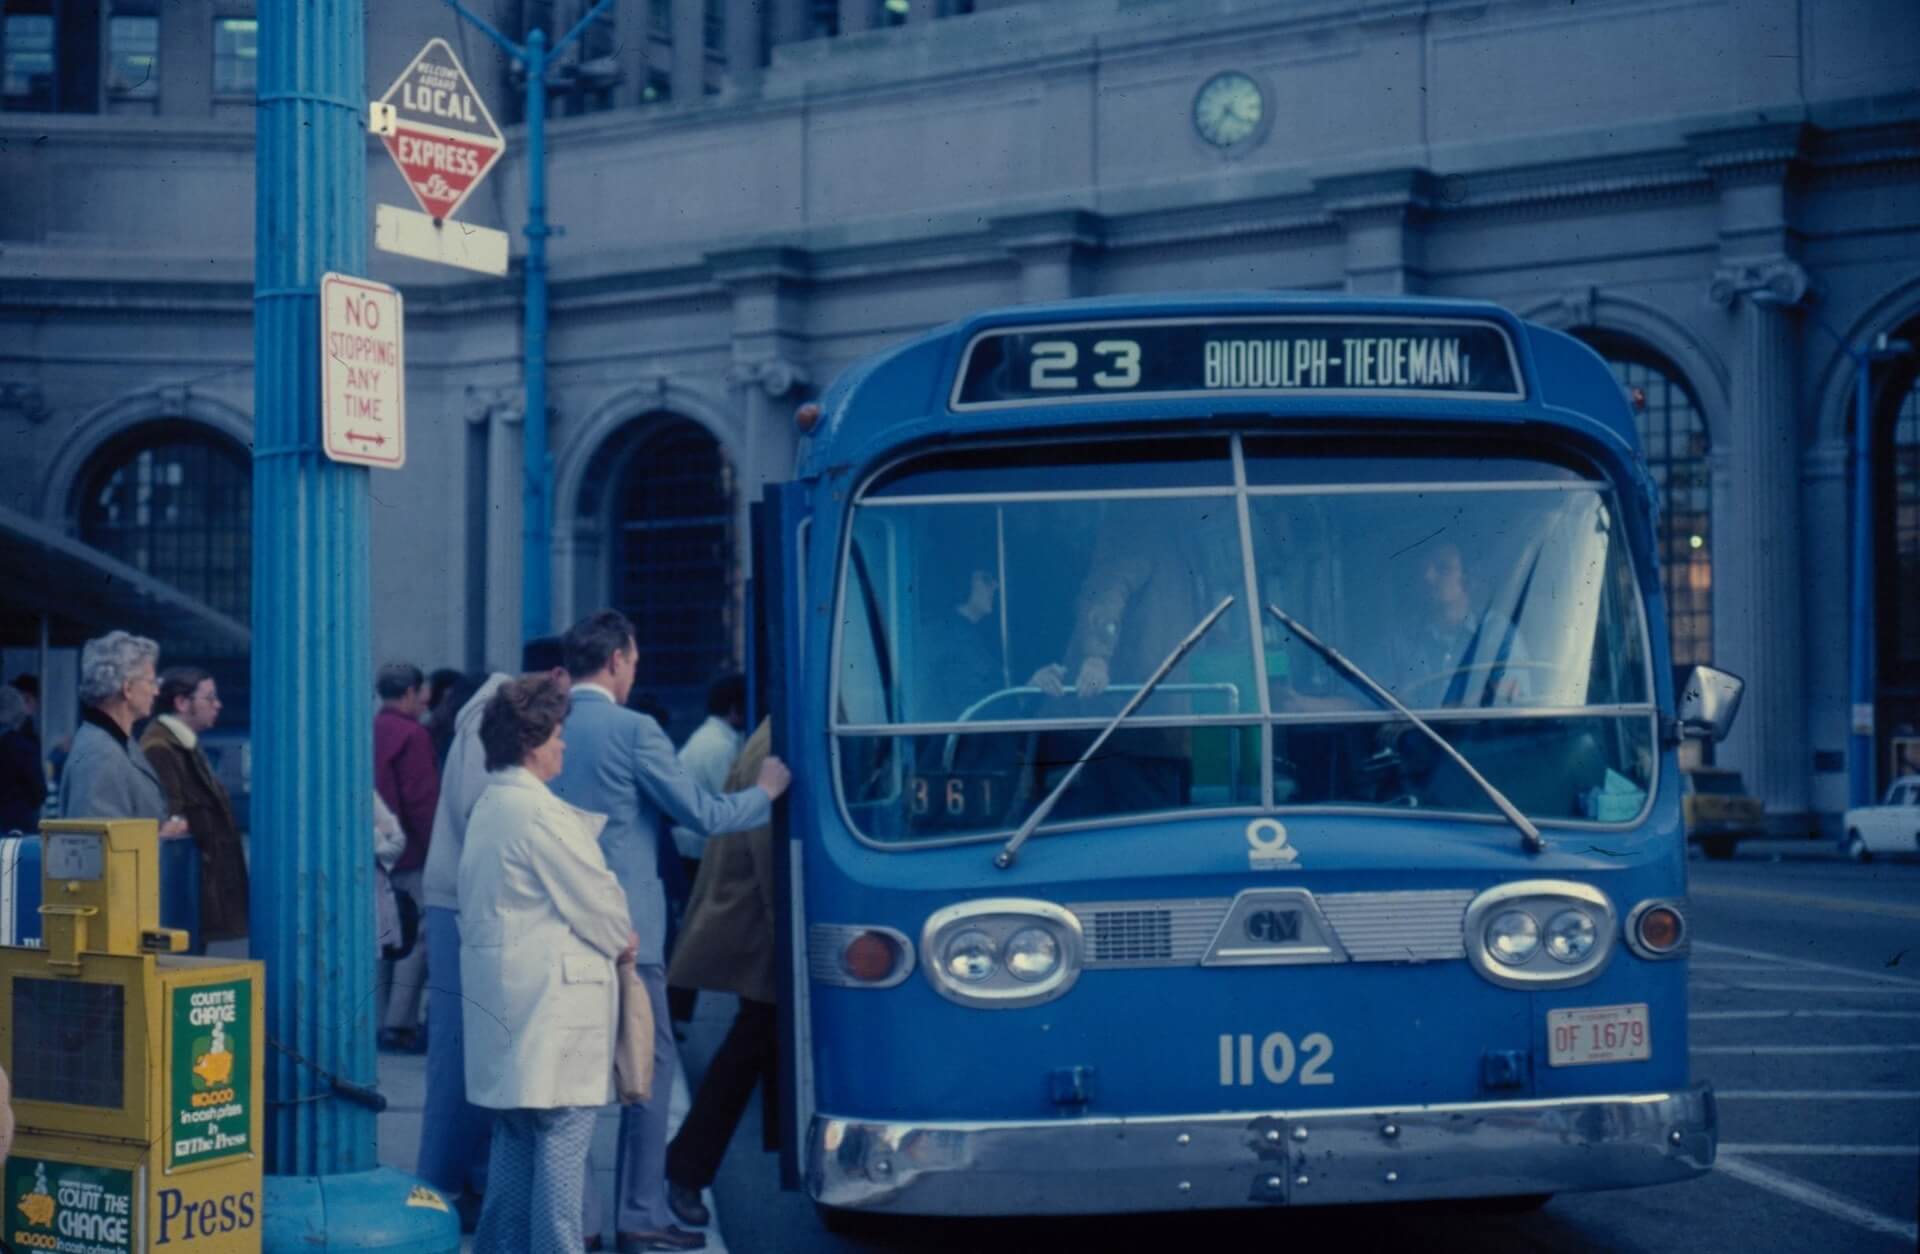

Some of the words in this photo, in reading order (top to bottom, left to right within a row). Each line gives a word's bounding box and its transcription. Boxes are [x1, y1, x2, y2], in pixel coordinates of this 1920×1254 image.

[403, 82, 477, 123] LOCAL
[398, 135, 479, 177] EXPRESS
[345, 296, 380, 330] NO
[330, 331, 395, 367] STOPPING
[346, 368, 381, 393] ANY
[344, 393, 383, 422] TIME
[1244, 908, 1303, 943] GM
[189, 1004, 236, 1026] CHANGE
[190, 991, 222, 1007] COUNT
[1591, 1020, 1643, 1052] 1679
[1219, 1031, 1335, 1086] 1102
[181, 1109, 191, 1125] in
[191, 1106, 216, 1123] cash
[207, 1121, 219, 1136] in
[190, 1136, 213, 1154] The
[214, 1132, 247, 1151] Press
[58, 1187, 101, 1211] COUNT
[103, 1193, 129, 1215] THE
[155, 1188, 255, 1246] Press
[58, 1209, 129, 1244] CHANGE
